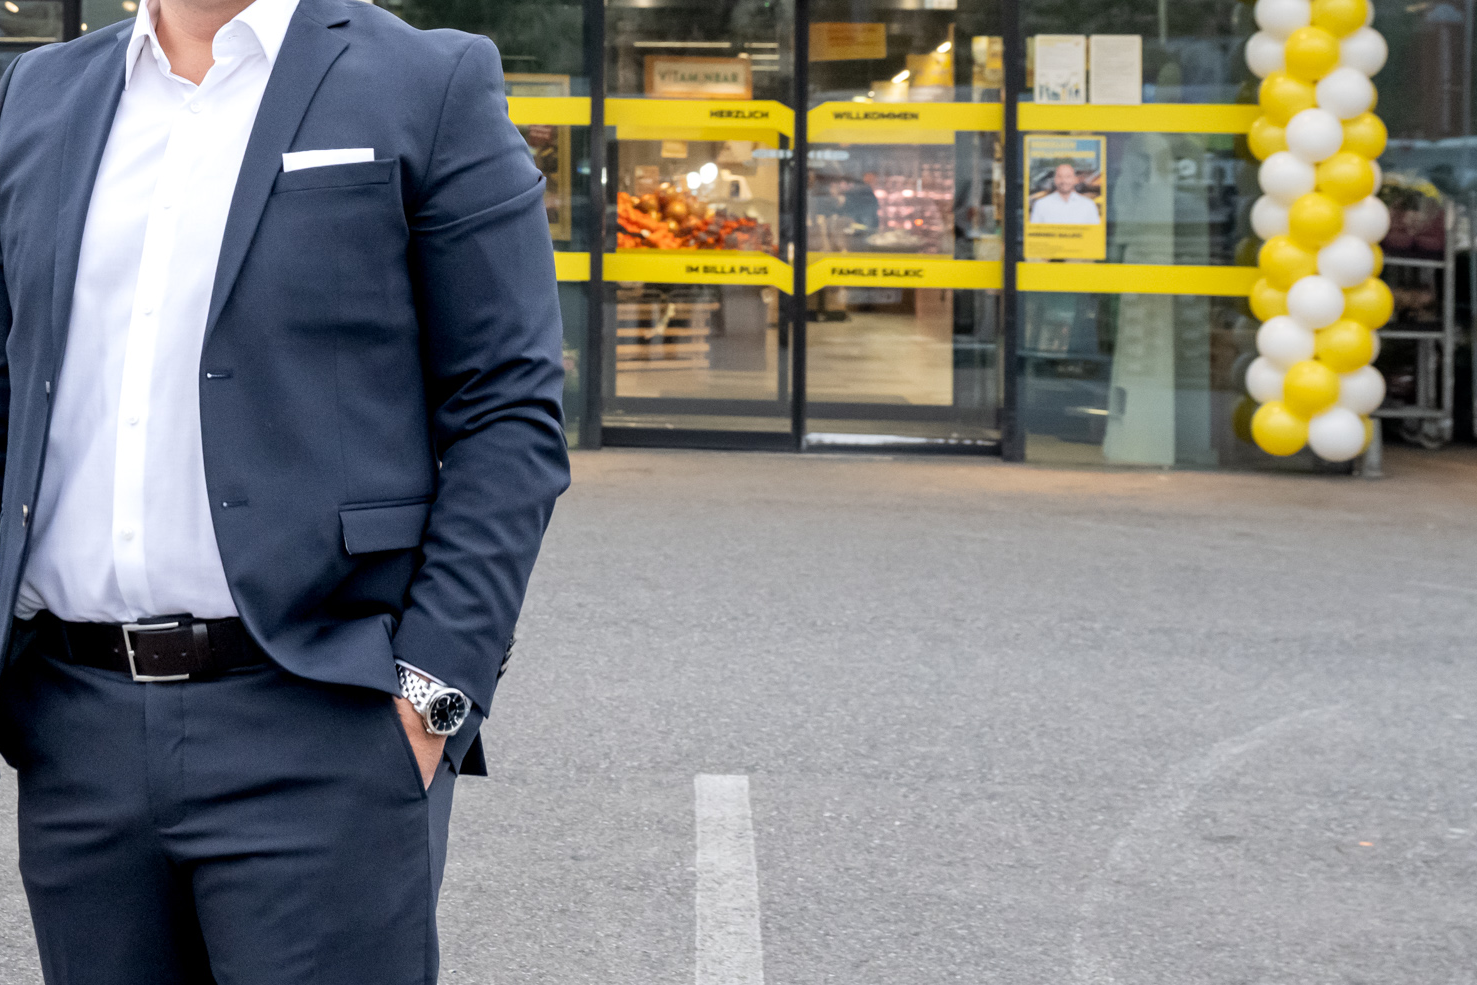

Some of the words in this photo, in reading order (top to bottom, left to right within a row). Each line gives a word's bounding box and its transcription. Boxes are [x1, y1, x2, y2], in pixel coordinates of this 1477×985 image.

[709, 109, 770, 120] HERZLICH
[832, 110, 920, 121] WILLKOMMEN
[685, 265, 699, 274] IM
[702, 265, 736, 274] BILLA
[739, 266, 769, 276] PLUS
[830, 267, 879, 277] FAMILIE
[881, 268, 924, 278] SALKIC
